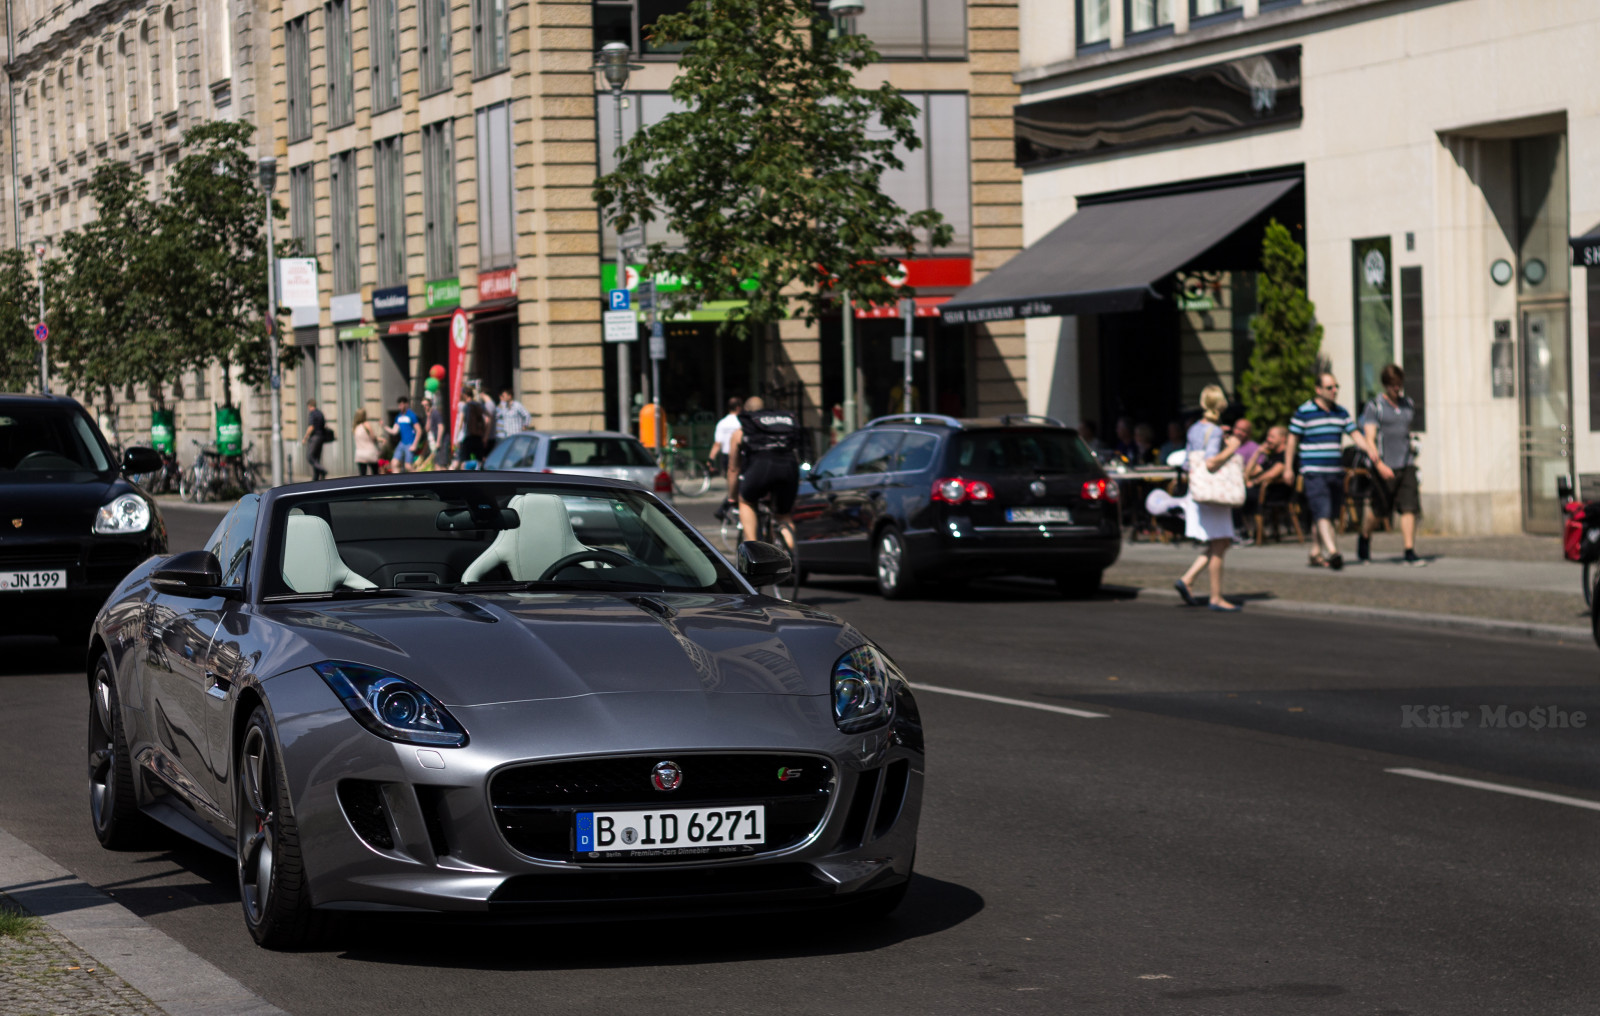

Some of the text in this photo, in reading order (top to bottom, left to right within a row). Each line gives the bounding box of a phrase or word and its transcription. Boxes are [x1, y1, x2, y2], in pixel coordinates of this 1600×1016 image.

[612, 292, 624, 308] P
[11, 572, 59, 588] JN 199
[597, 810, 761, 847] B ID 6271
[581, 835, 589, 845] D
